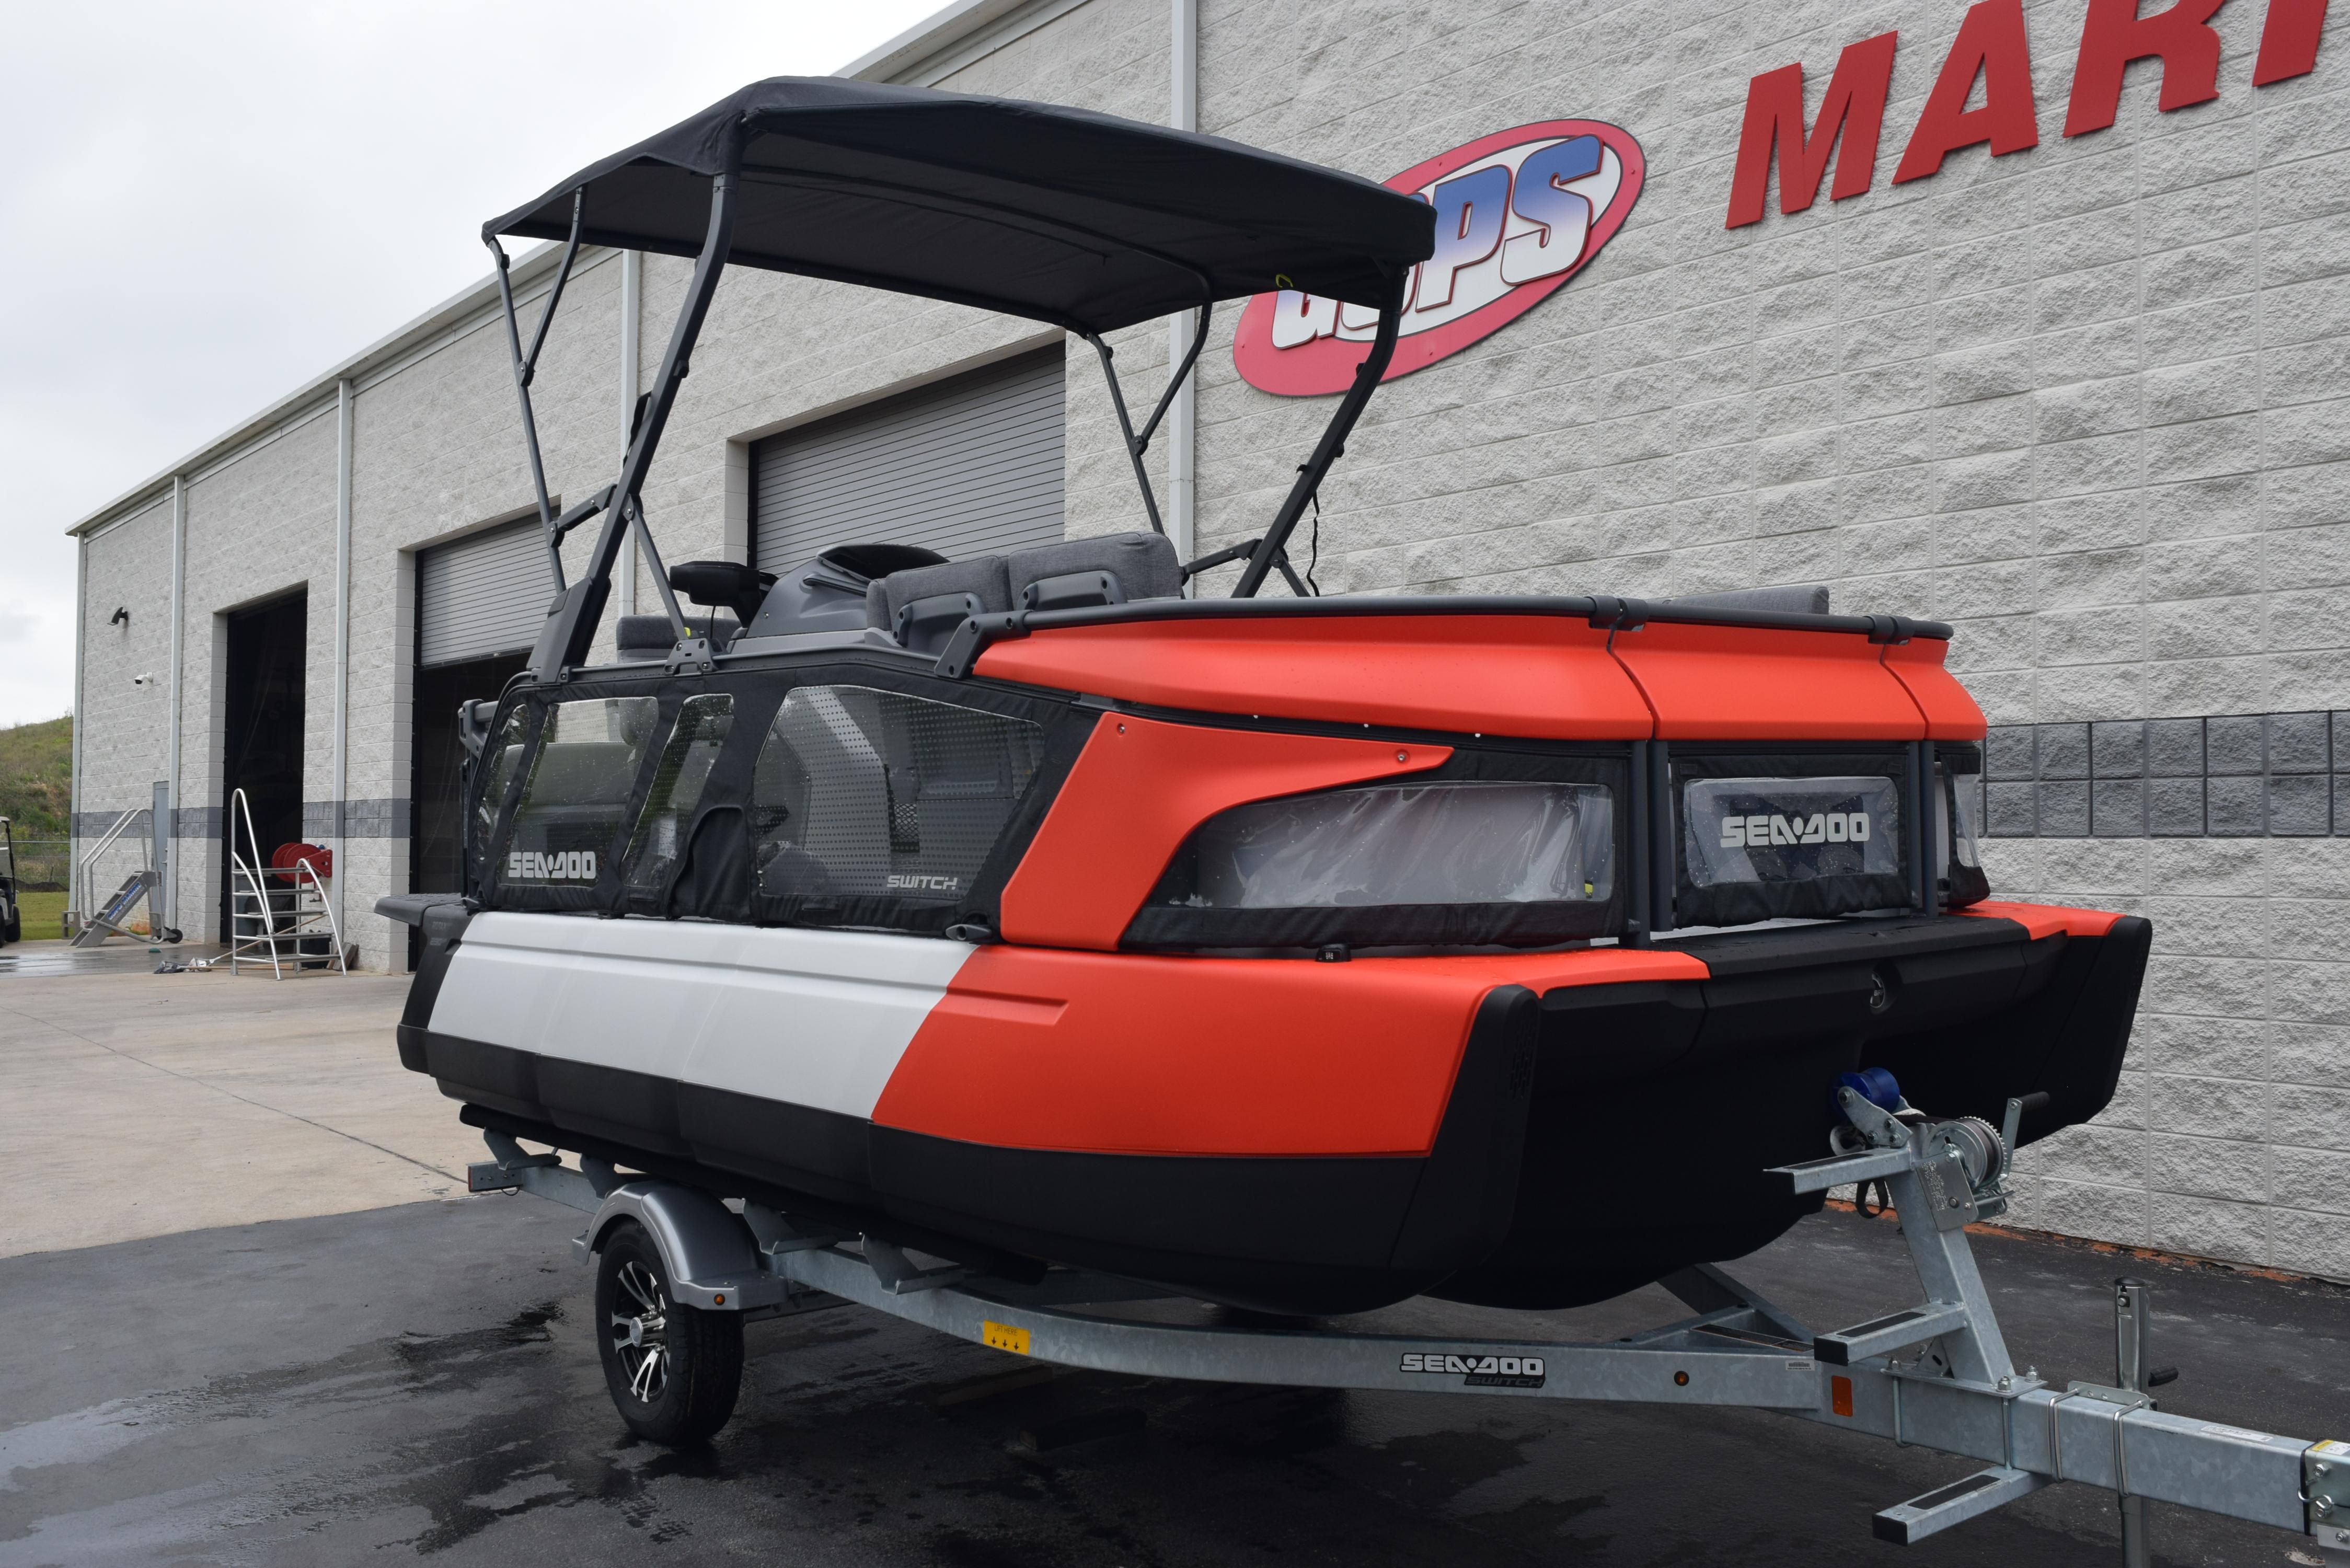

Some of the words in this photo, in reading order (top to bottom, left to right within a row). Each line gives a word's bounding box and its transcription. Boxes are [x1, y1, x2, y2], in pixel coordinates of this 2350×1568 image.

[886, 875, 958, 890] SWITCH
[1004, 1327, 1017, 1336] HERE
[1466, 1376, 1542, 1387] SWITCH
